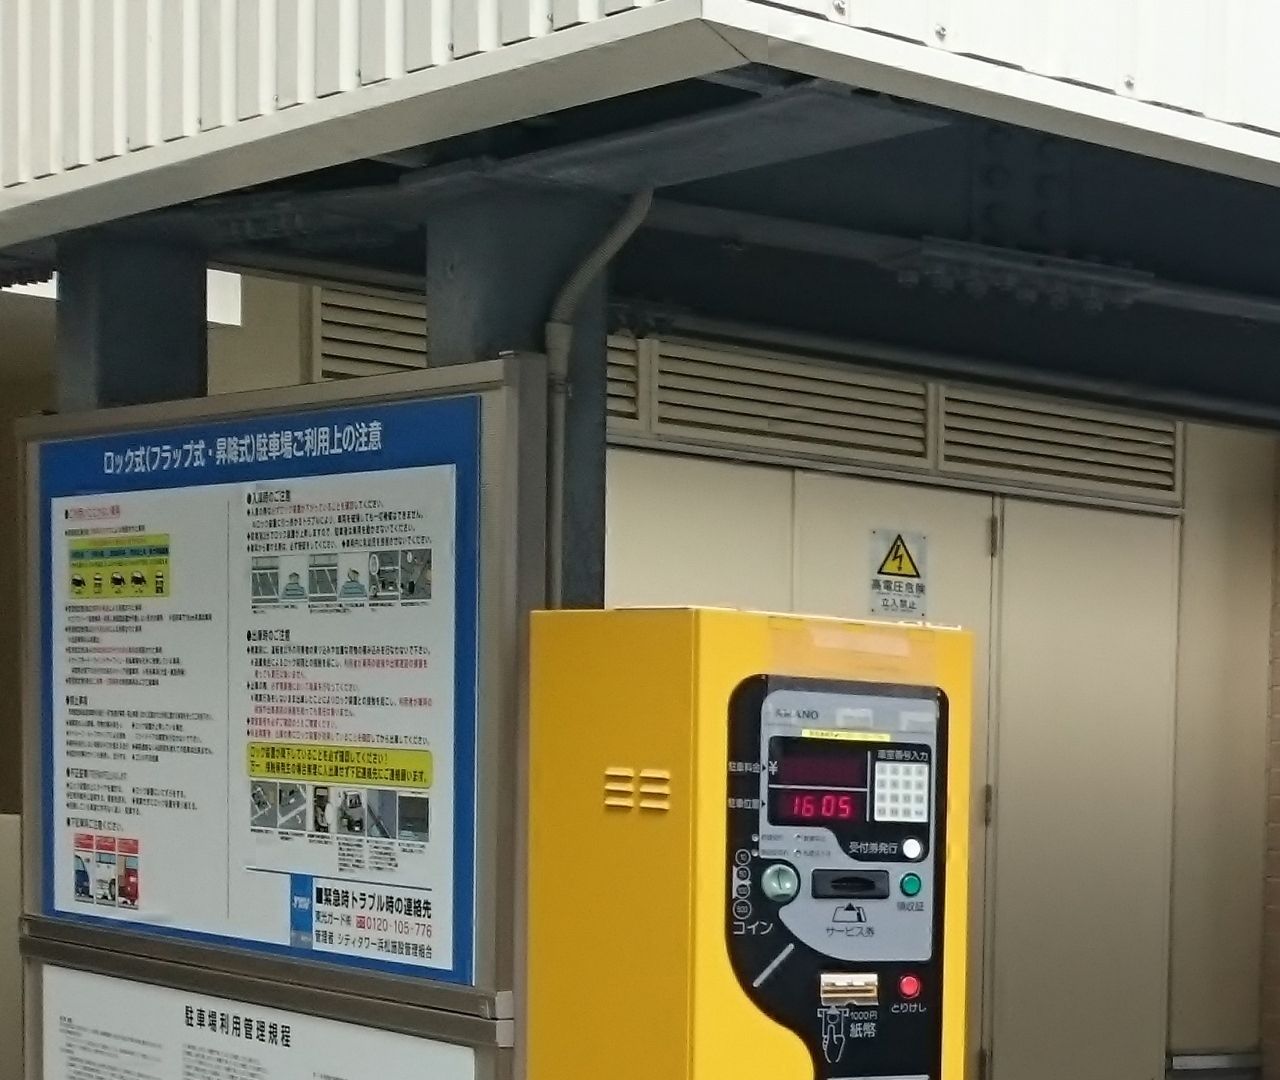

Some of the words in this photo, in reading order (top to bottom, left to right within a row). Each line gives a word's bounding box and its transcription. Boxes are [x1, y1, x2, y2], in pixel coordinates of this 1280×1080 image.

[733, 921, 774, 935] コイン
[826, 926, 875, 938] サービス券
[891, 1003, 927, 1014] とりけし
[184, 1005, 291, 1048] 駐車場利用管理規程
